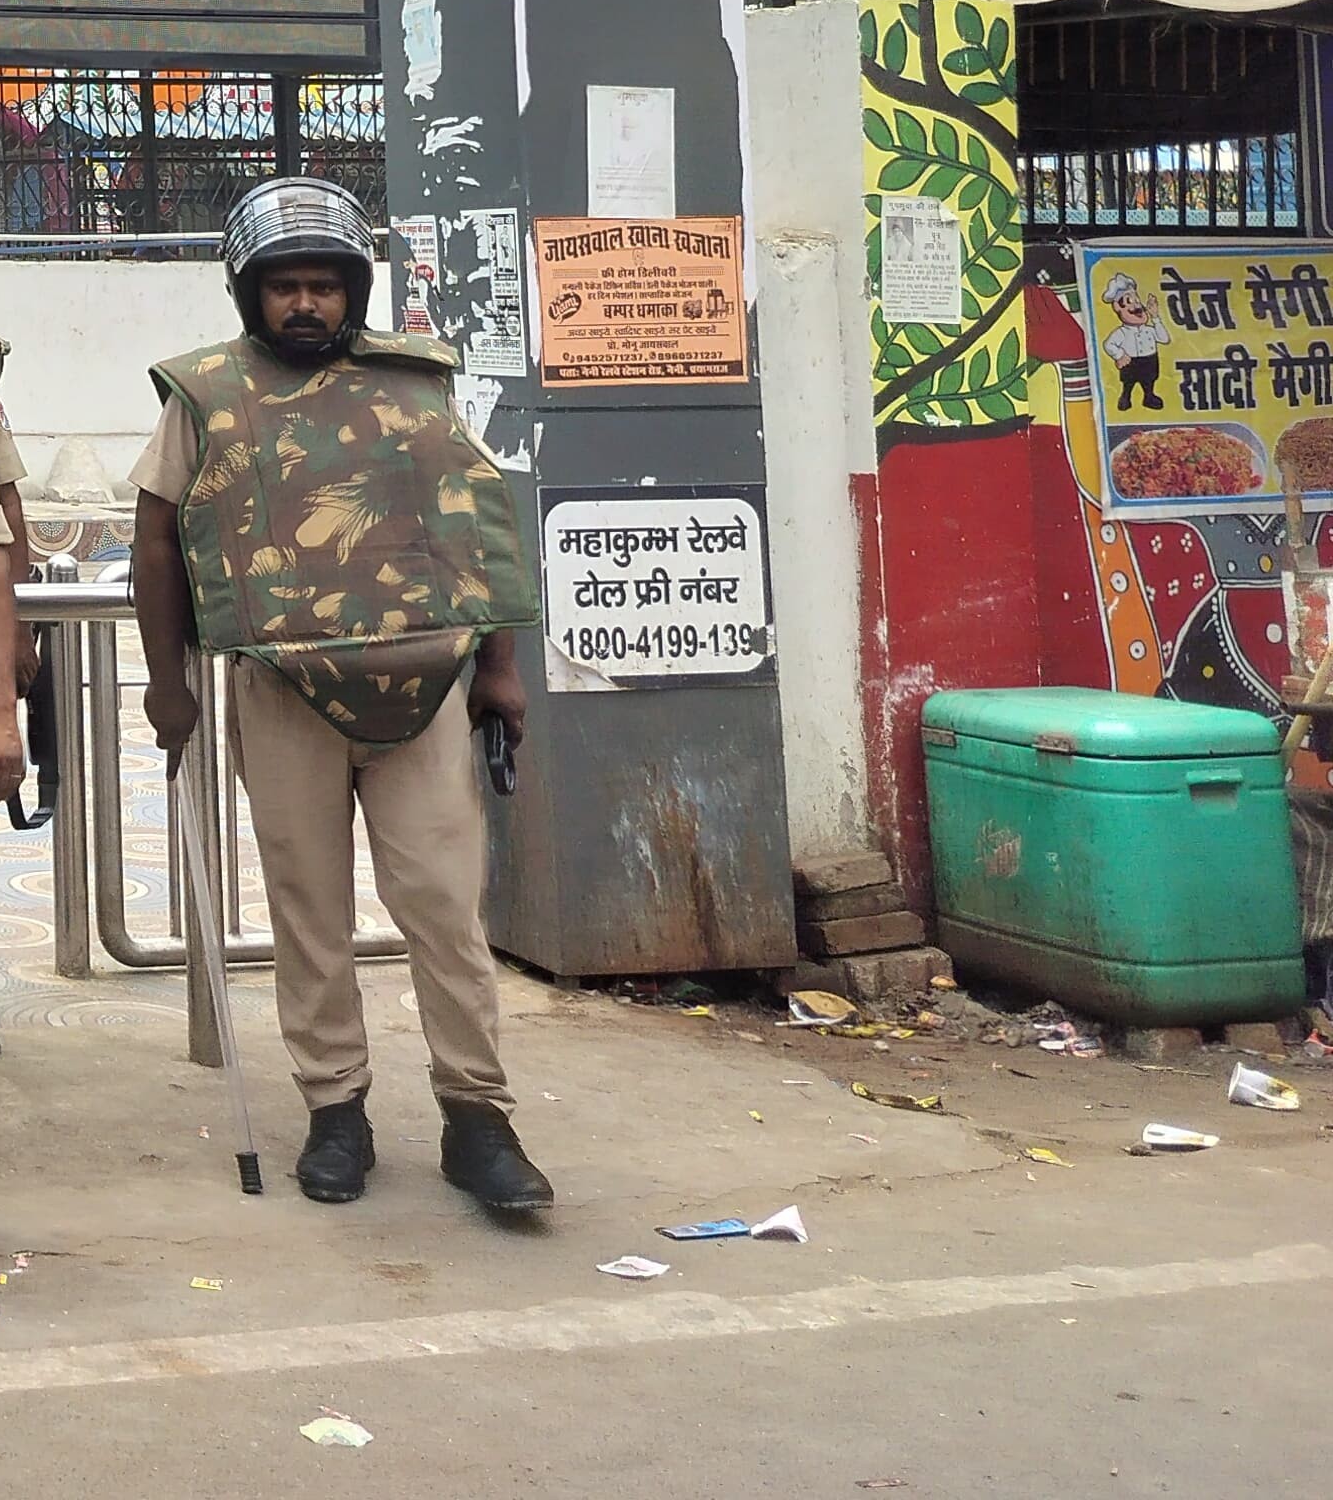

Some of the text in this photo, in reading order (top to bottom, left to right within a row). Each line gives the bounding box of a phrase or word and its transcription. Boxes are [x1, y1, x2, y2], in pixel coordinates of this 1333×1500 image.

[543, 225, 731, 262] जायसवाल खाना खजाना
[617, 267, 635, 278] होम
[602, 302, 678, 319] बम्पर धमाका
[1159, 263, 1333, 331] वेज मैगी
[1176, 341, 1333, 411] सादी मैगी
[557, 514, 748, 568] महाकुम्भ रेलवे
[573, 567, 740, 610] टोल फ्री नंबर
[562, 623, 753, 661] 1800-4199-139
